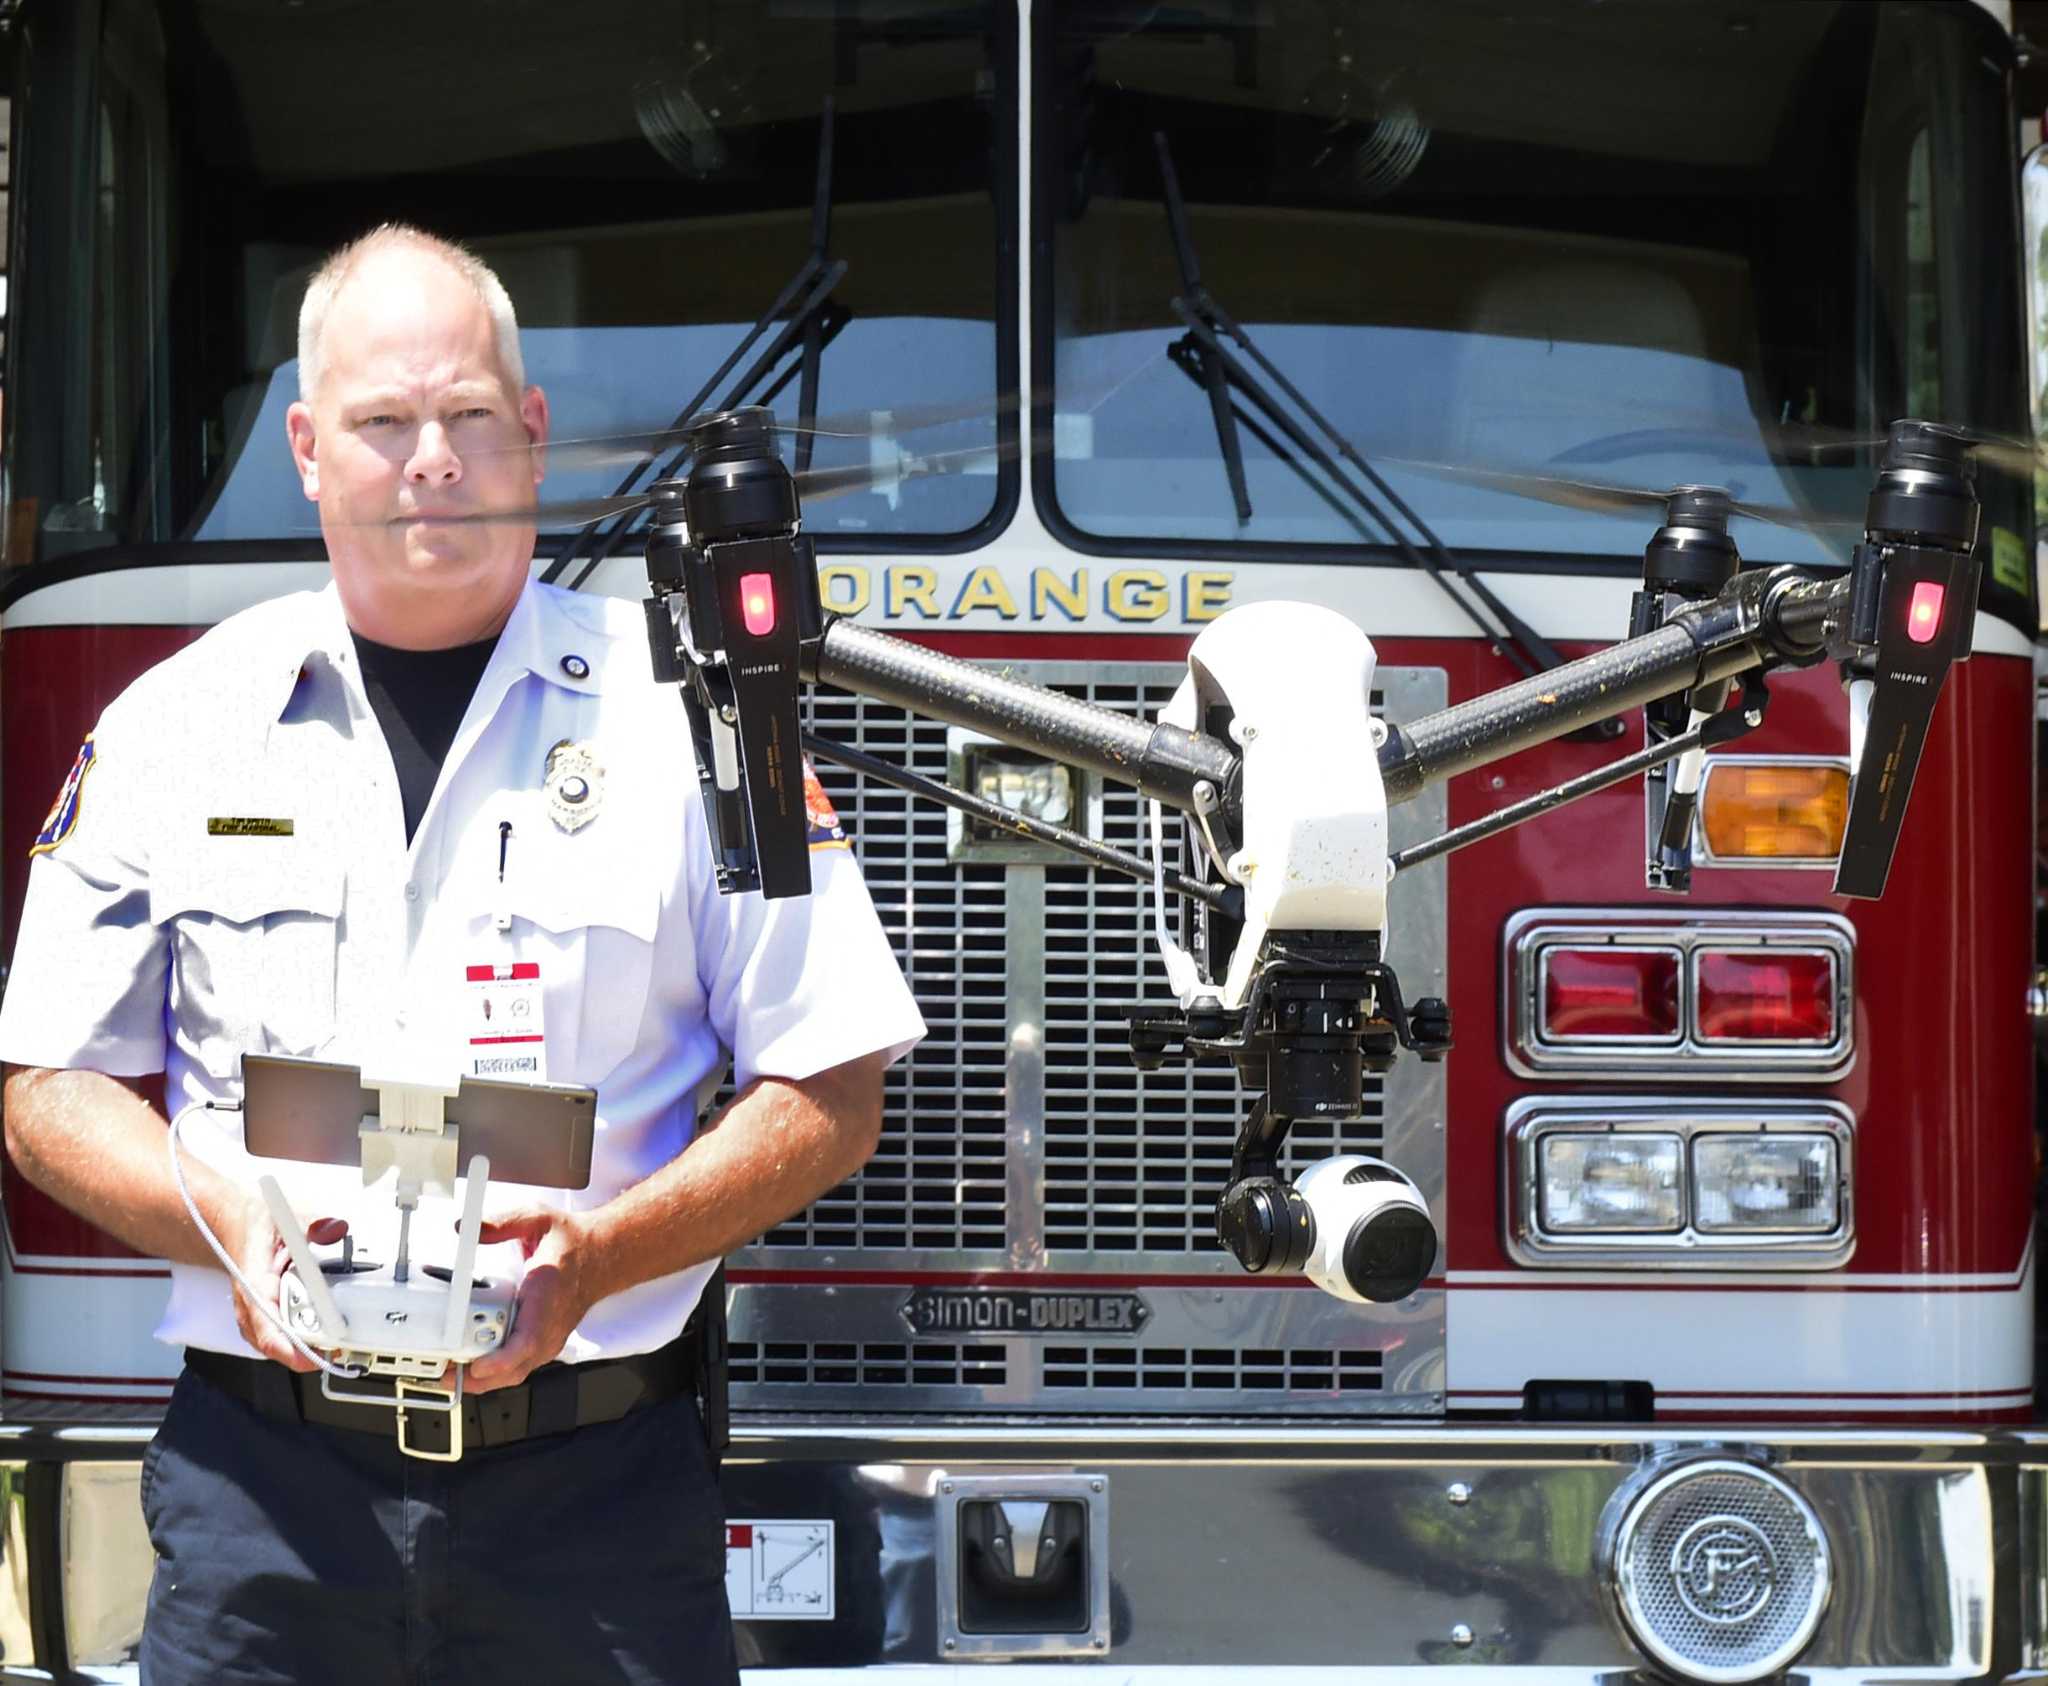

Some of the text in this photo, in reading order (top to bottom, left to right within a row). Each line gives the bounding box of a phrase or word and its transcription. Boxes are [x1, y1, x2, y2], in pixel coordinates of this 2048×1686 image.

[819, 565, 1236, 624] ORANGE
[741, 663, 780, 676] INSPIRE
[1890, 671, 1928, 685] INSPIRE
